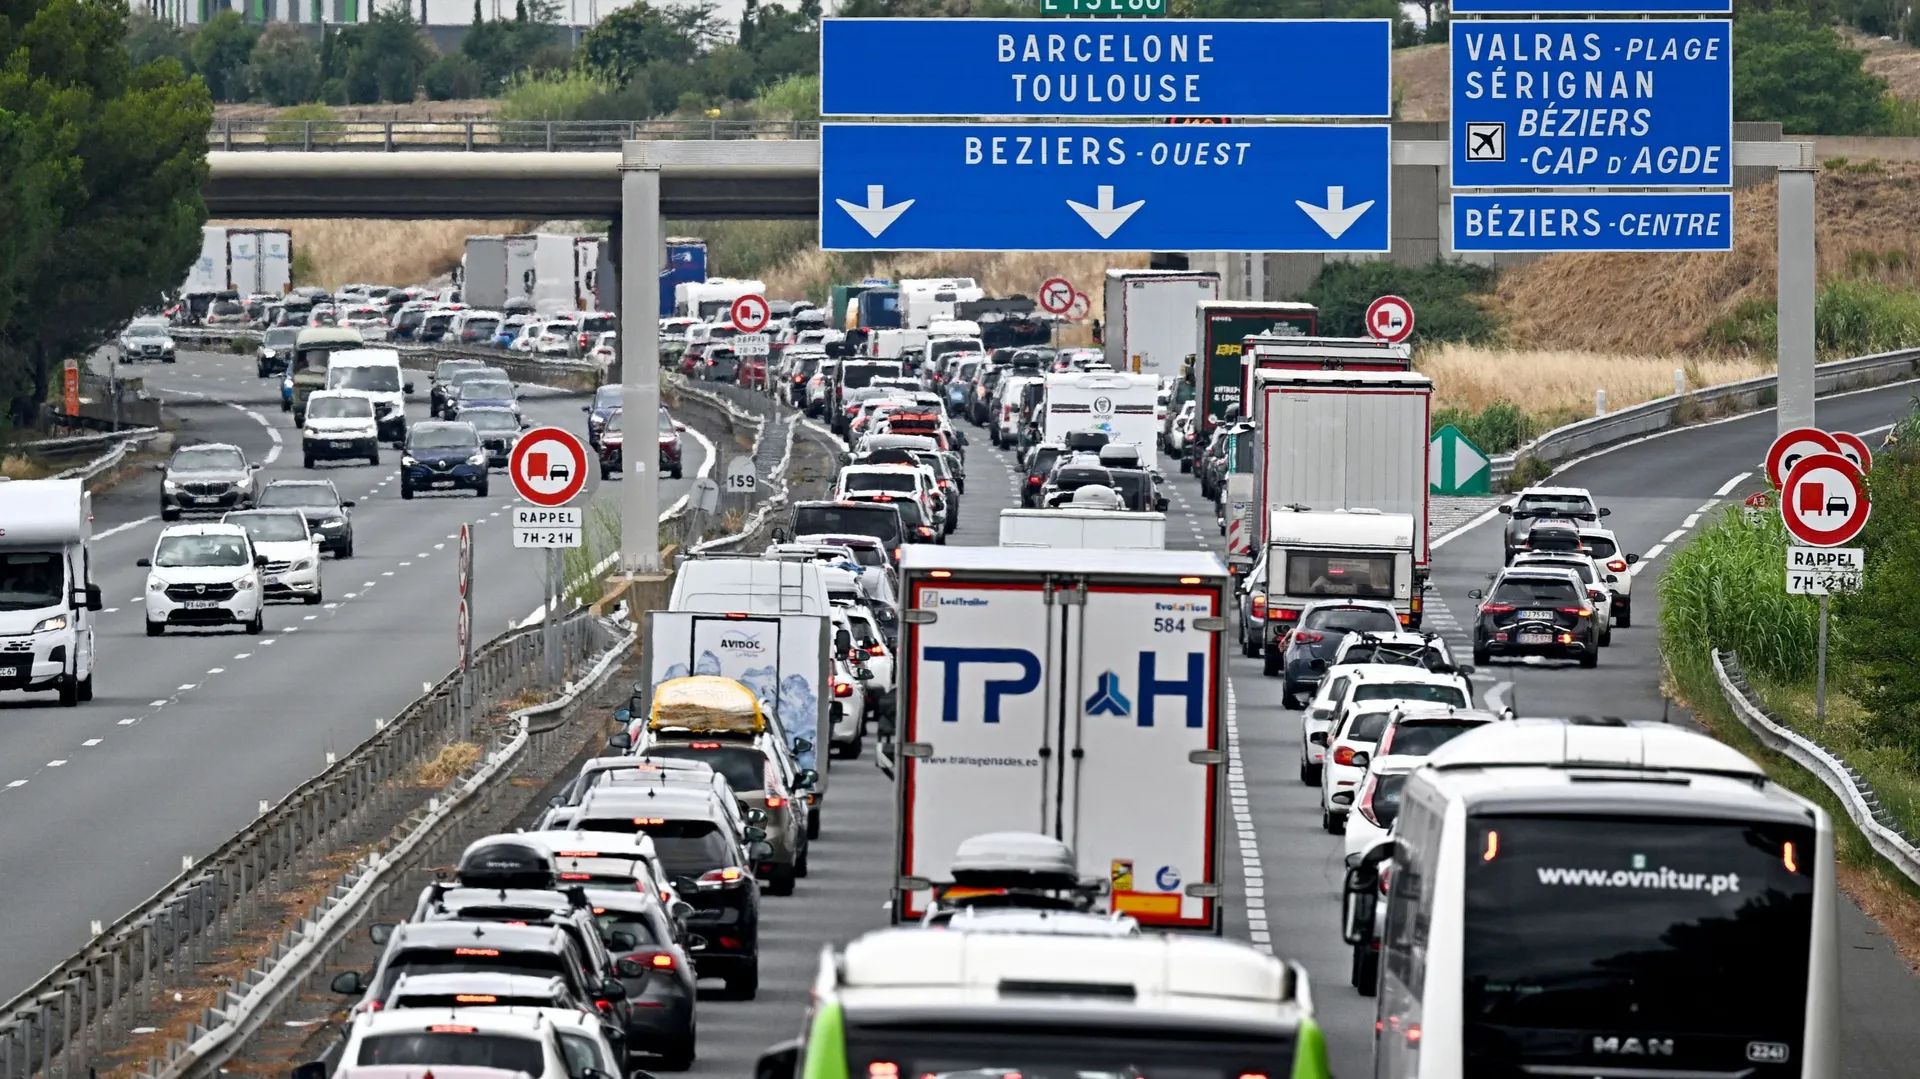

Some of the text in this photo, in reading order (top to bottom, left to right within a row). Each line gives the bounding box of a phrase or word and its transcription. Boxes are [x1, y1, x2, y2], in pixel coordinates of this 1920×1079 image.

[998, 34, 1214, 63] BARCELONE
[1465, 33, 1601, 61] VALRAS
[1011, 74, 1201, 103] TOULOUSE
[1465, 65, 1653, 99] SÉRIGNAN
[1518, 101, 1652, 137] BÉZIERS
[965, 136, 1126, 165] BEZIERS
[1630, 145, 1721, 174] AGDE
[1465, 203, 1601, 237] BÉZIERS
[727, 475, 755, 488] 159
[519, 512, 575, 524] RAPPEL
[522, 532, 574, 544] 7H-21H
[1794, 552, 1856, 567] RAPPEL
[1154, 617, 1186, 633] 584
[720, 639, 760, 649] AVIDOC
[923, 646, 1042, 723] TP
[1536, 865, 1740, 895] www.ovnitur.pt
[1592, 1035, 1675, 1056] MAN
[1752, 1045, 1784, 1060] 2241
